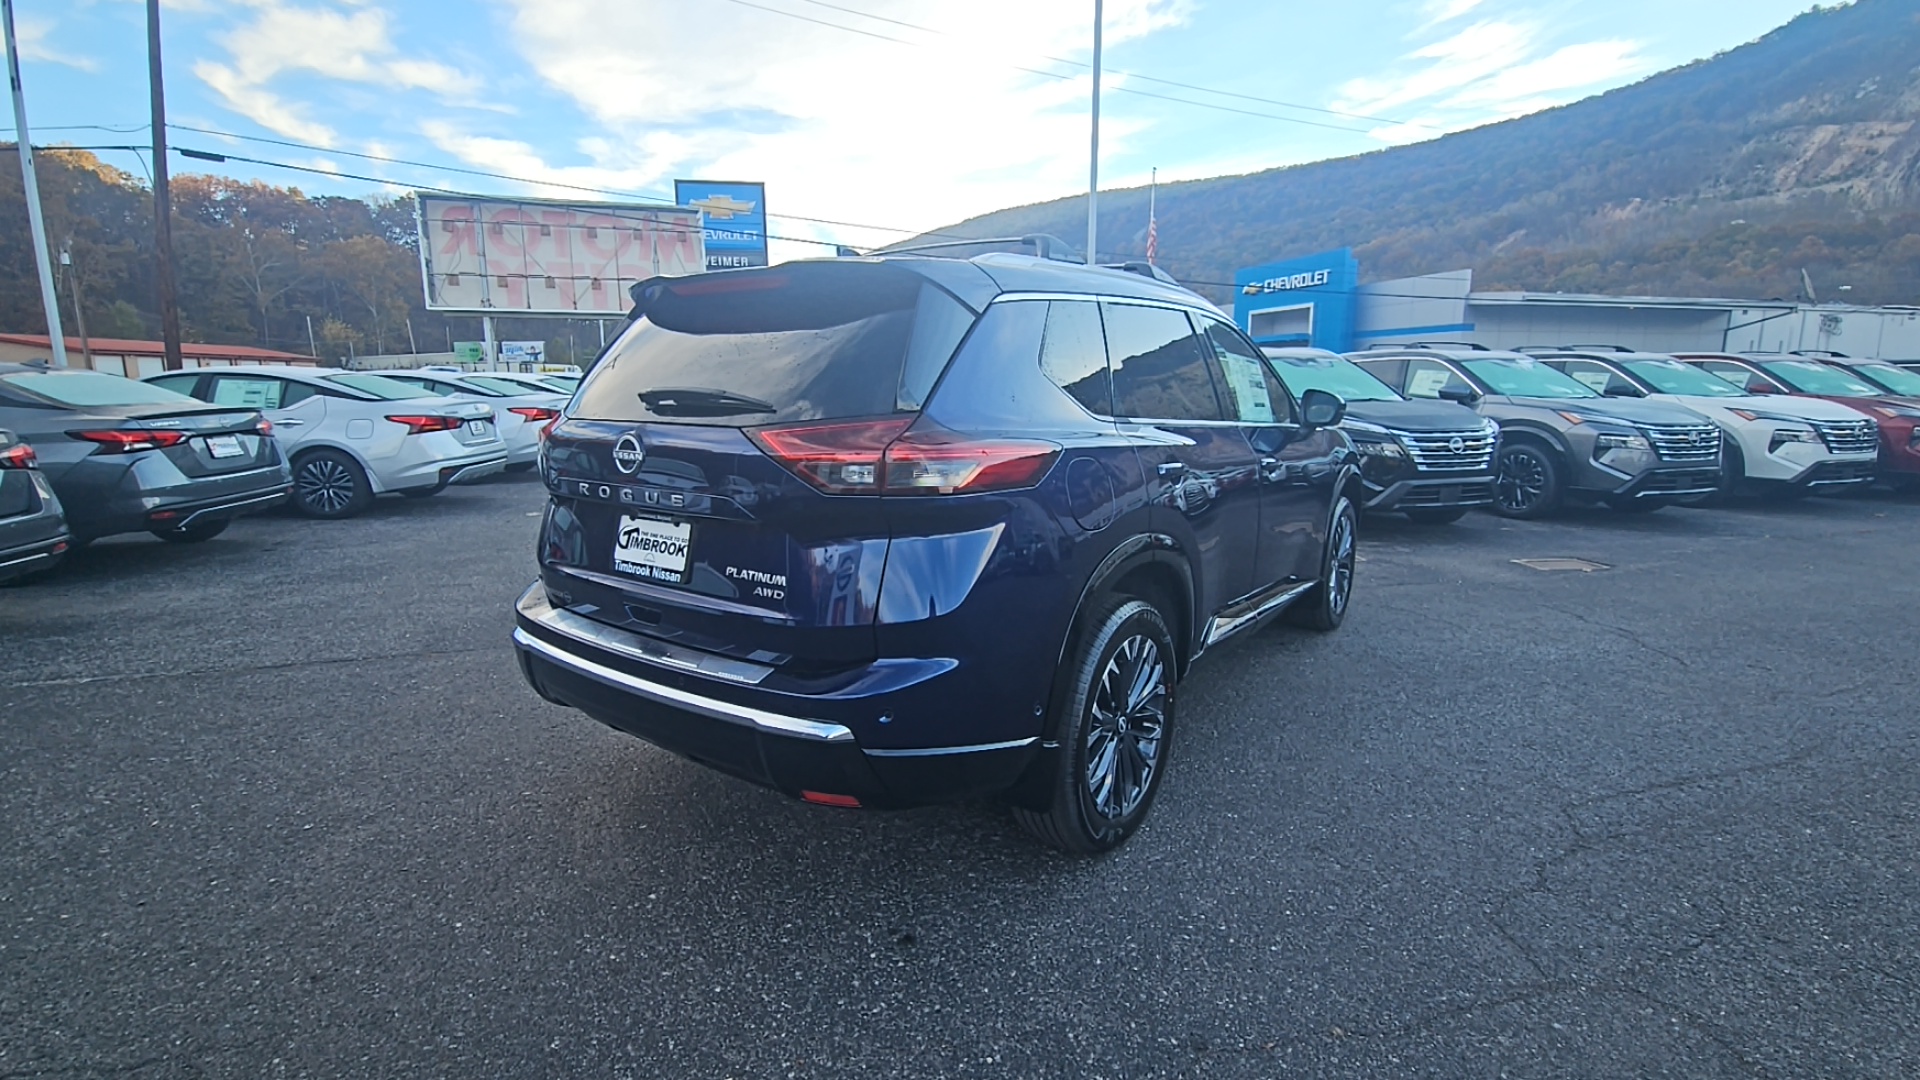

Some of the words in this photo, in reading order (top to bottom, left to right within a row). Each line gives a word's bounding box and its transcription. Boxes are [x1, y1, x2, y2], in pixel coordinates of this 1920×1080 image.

[704, 229, 758, 241] EVROLET
[1264, 269, 1331, 293] CHEVROLET
[579, 482, 684, 507] ROGUE
[617, 525, 688, 558] TIMBROOK
[615, 560, 651, 577] Timbrook
[652, 567, 681, 582] Nissan
[726, 566, 787, 586] PLATINUM
[753, 586, 785, 600] AWD
